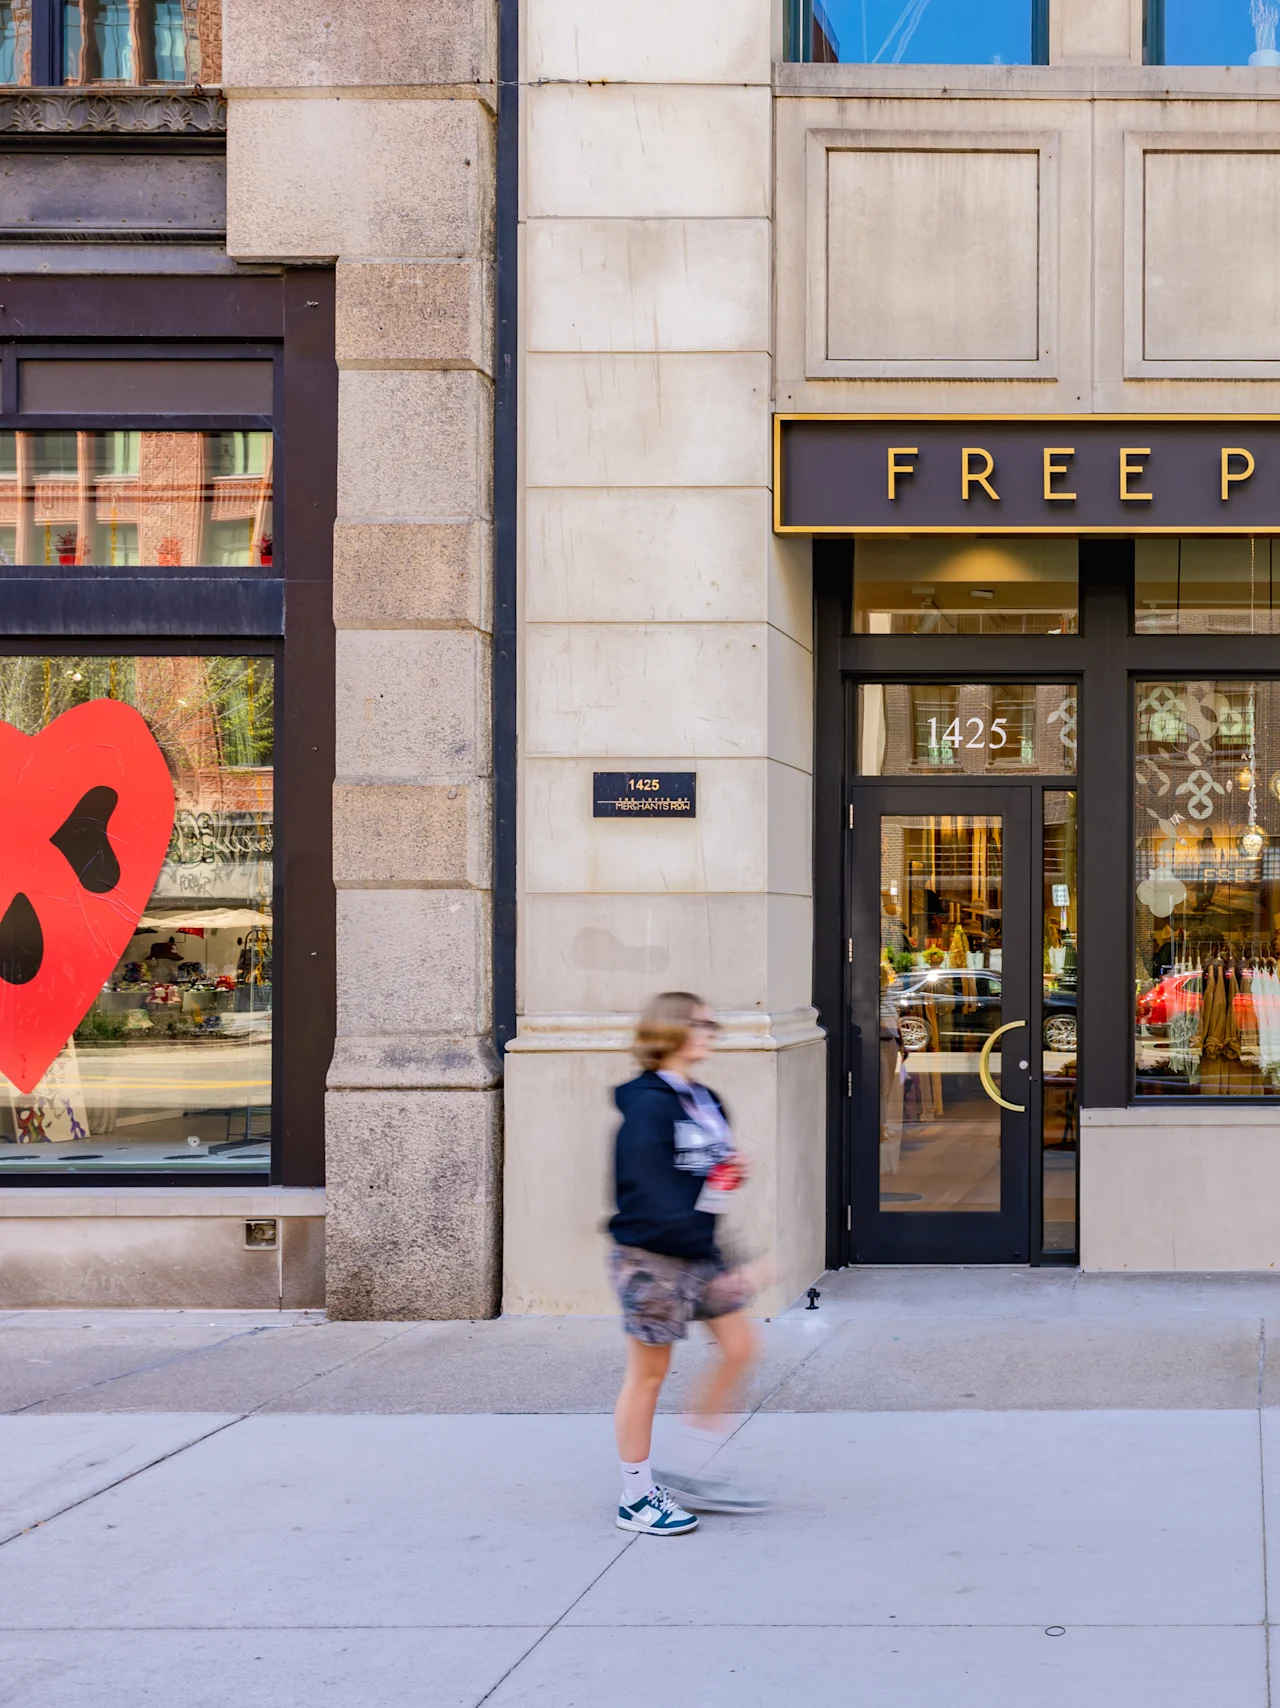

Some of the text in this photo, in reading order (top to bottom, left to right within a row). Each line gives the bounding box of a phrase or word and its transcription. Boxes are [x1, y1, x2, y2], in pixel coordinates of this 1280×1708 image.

[887, 447, 1153, 500] FREE
[927, 716, 1008, 750] 1425
[628, 778, 660, 791] 1425
[615, 801, 690, 811] MERCHANTS ROW
[1203, 868, 1261, 883] FREE
